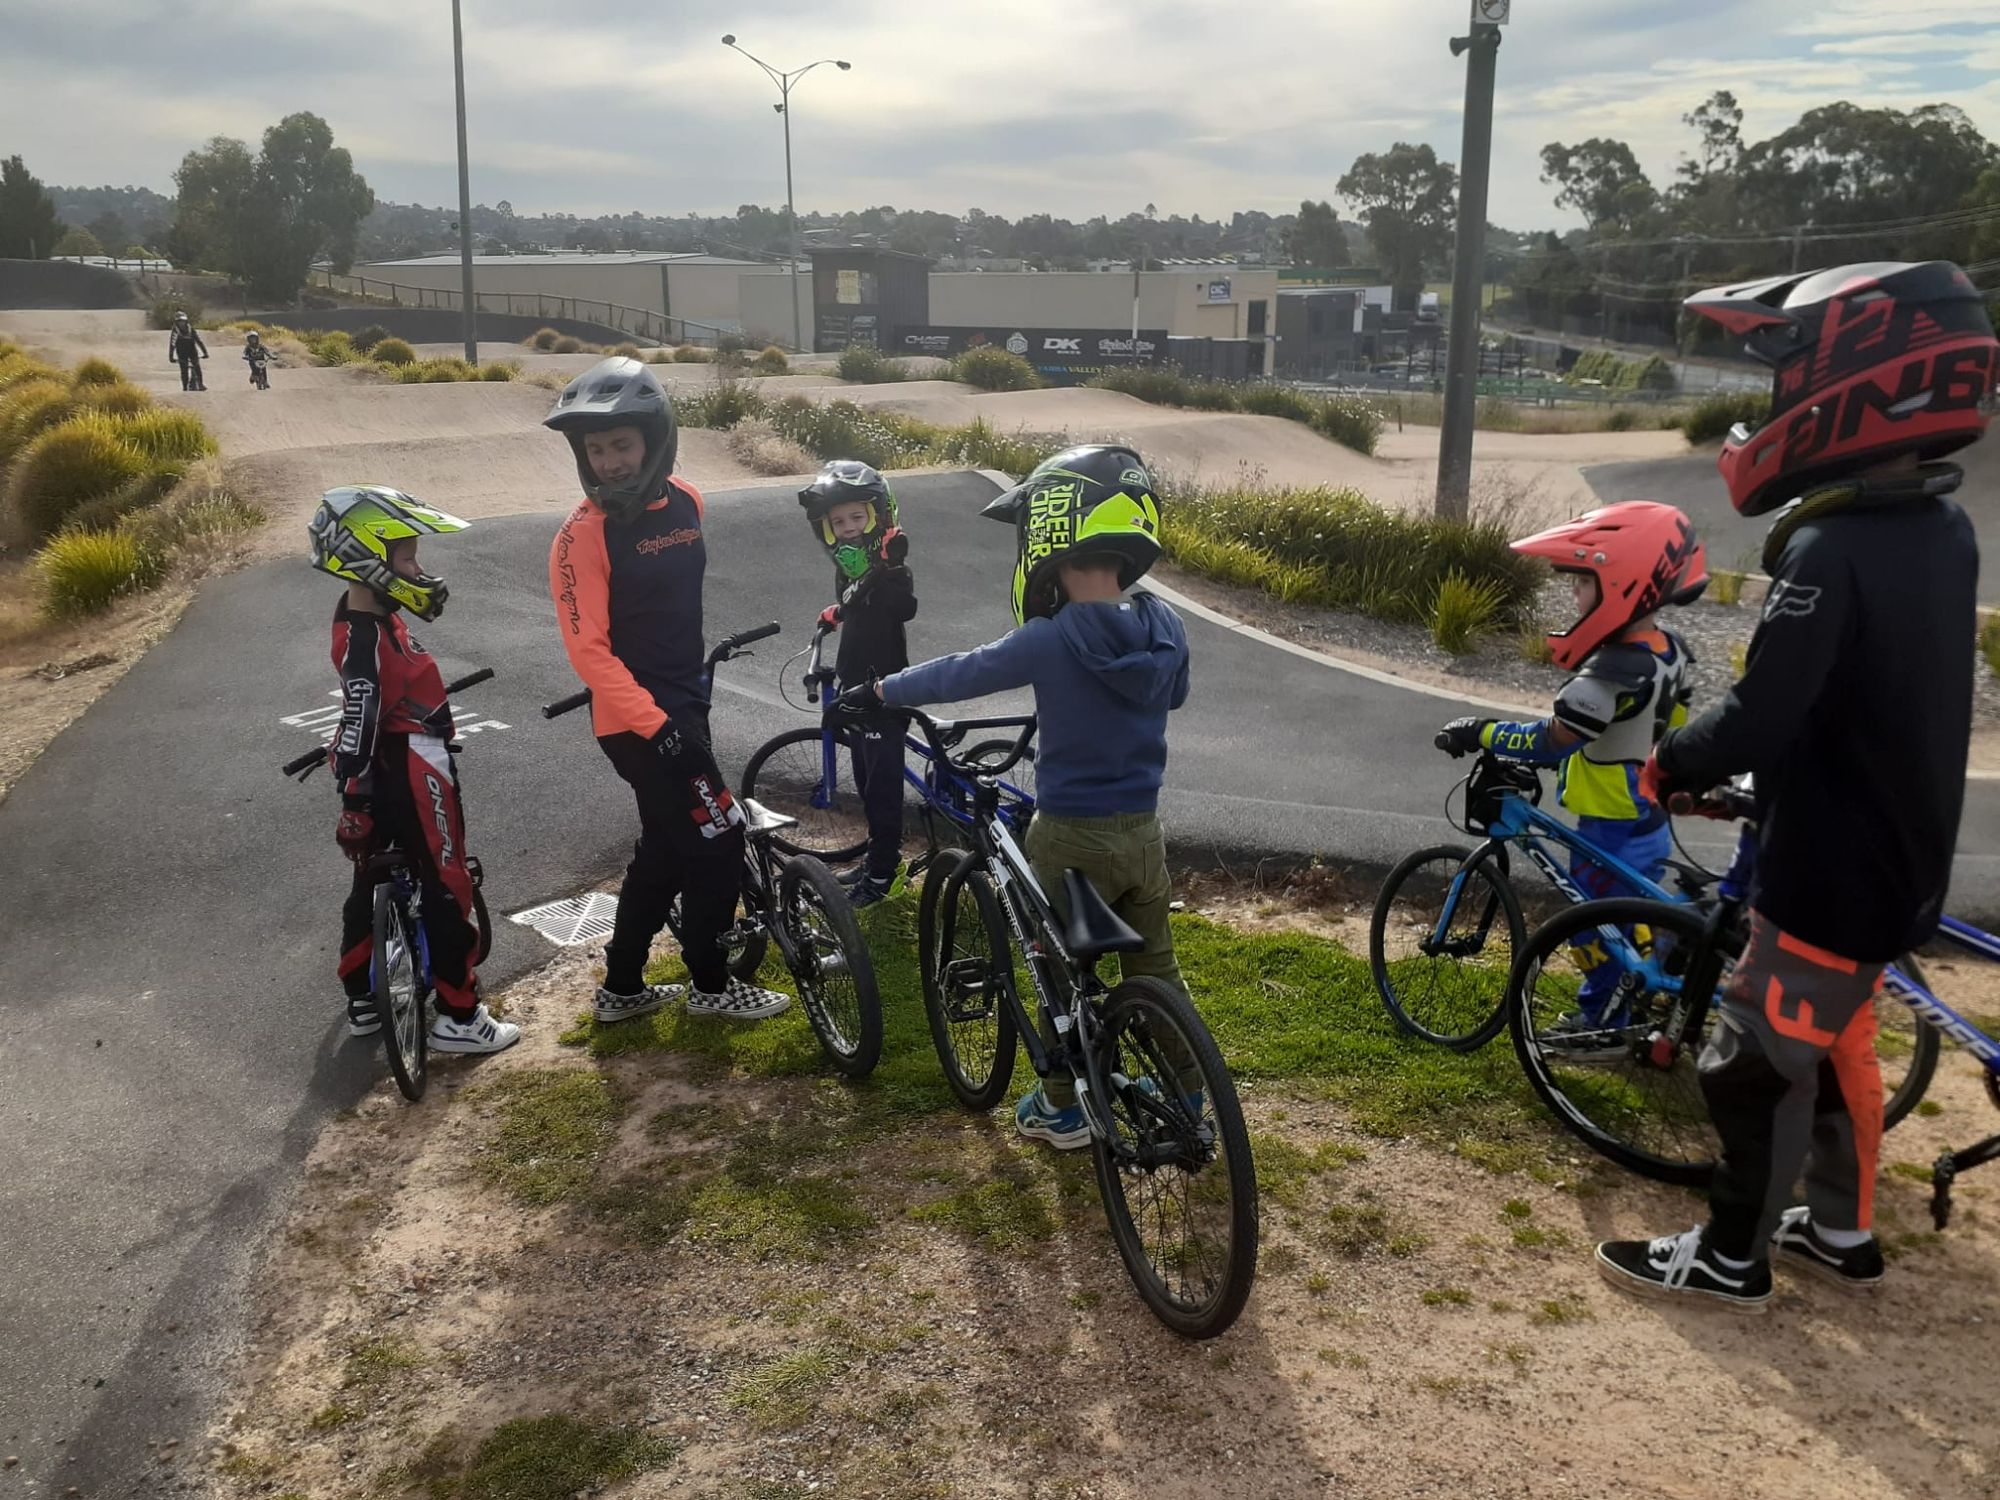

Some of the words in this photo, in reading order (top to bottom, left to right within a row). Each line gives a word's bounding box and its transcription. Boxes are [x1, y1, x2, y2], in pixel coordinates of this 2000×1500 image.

[1043, 338, 1082, 350] DK
[1067, 366, 1101, 374] VALLEY
[657, 729, 682, 756] FOX
[865, 731, 882, 740] FILA
[1494, 730, 1539, 751] FOX
[424, 772, 455, 868] ONEAL
